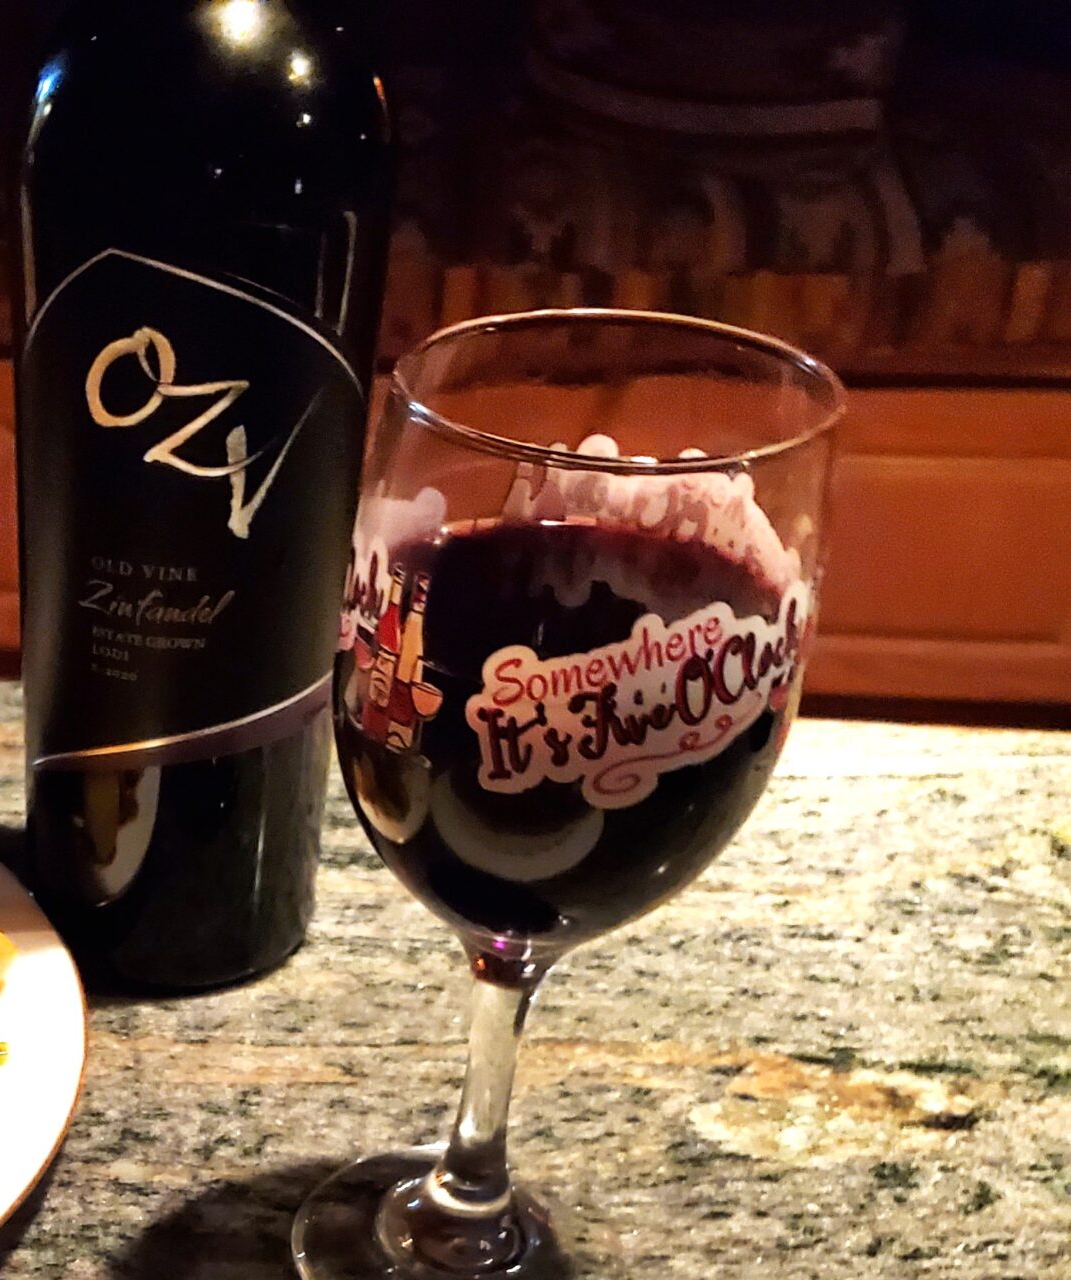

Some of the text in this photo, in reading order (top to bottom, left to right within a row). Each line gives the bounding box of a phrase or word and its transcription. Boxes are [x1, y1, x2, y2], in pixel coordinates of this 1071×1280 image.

[79, 579, 235, 626] Zinfandel
[91, 556, 198, 582] OLD VINE
[492, 616, 724, 706] Somewhere
[477, 702, 572, 780] It's
[568, 681, 679, 759] Five
